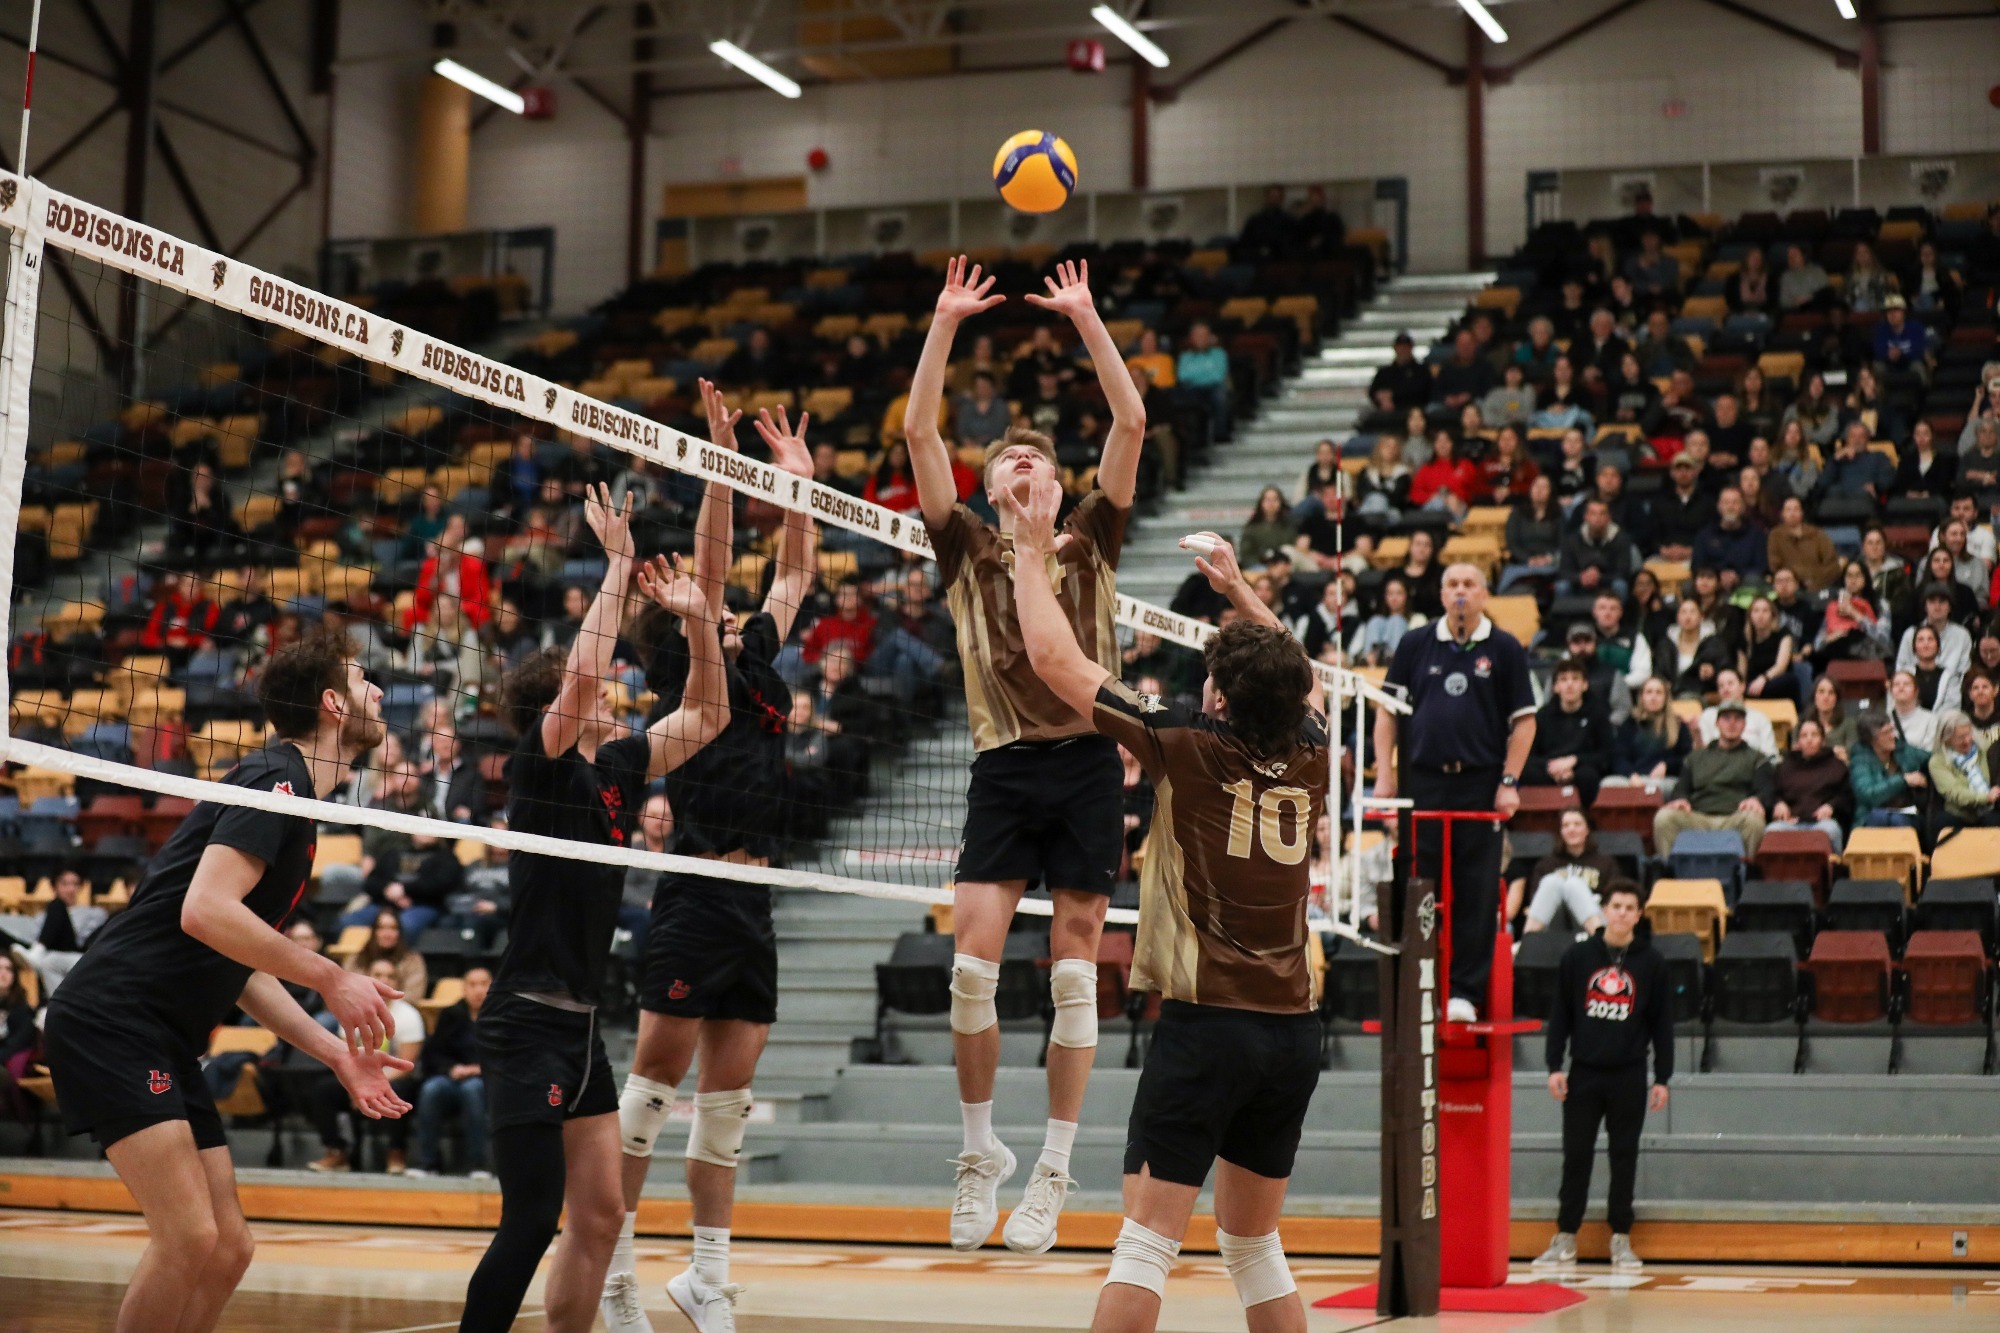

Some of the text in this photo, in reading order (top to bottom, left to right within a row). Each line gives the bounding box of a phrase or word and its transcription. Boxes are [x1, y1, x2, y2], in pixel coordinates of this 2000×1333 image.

[46, 198, 184, 276] GOBISONS.CA
[250, 275, 369, 344] GOBISONS.CA
[1221, 778, 1312, 866] 10
